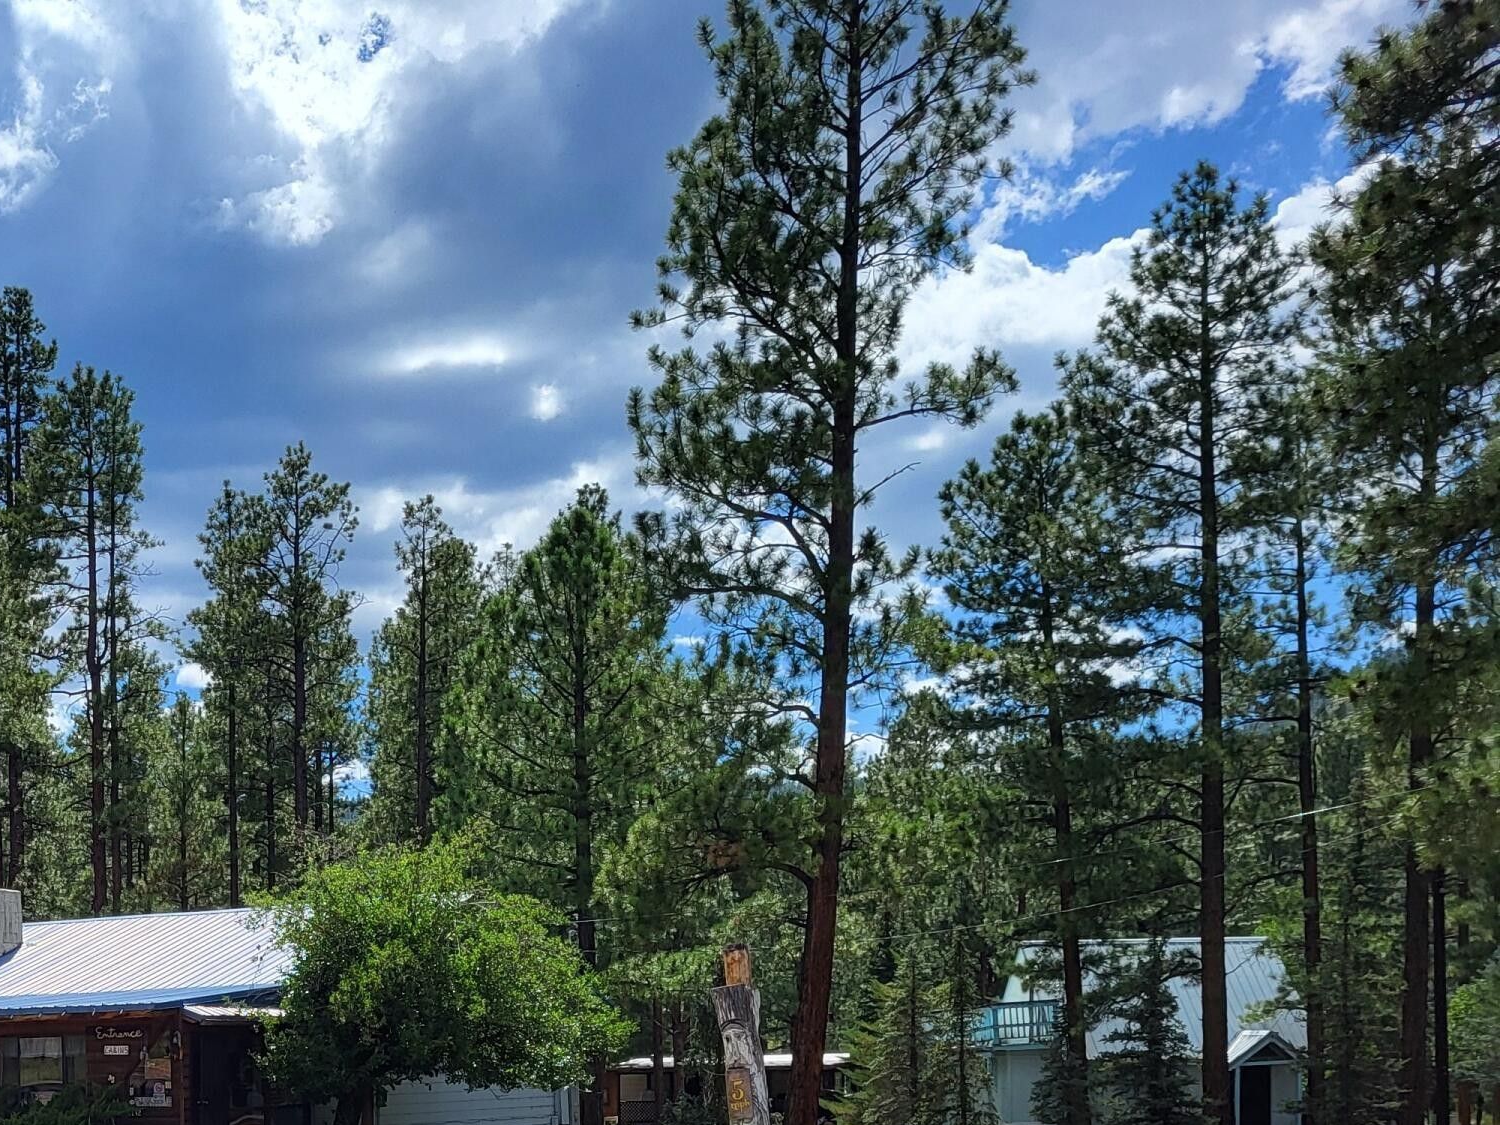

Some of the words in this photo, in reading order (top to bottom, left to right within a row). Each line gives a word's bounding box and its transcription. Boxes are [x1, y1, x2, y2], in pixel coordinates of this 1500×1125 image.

[95, 1026, 143, 1039] Entrance
[731, 1079, 745, 1101] 5
[730, 1099, 750, 1112] mph
